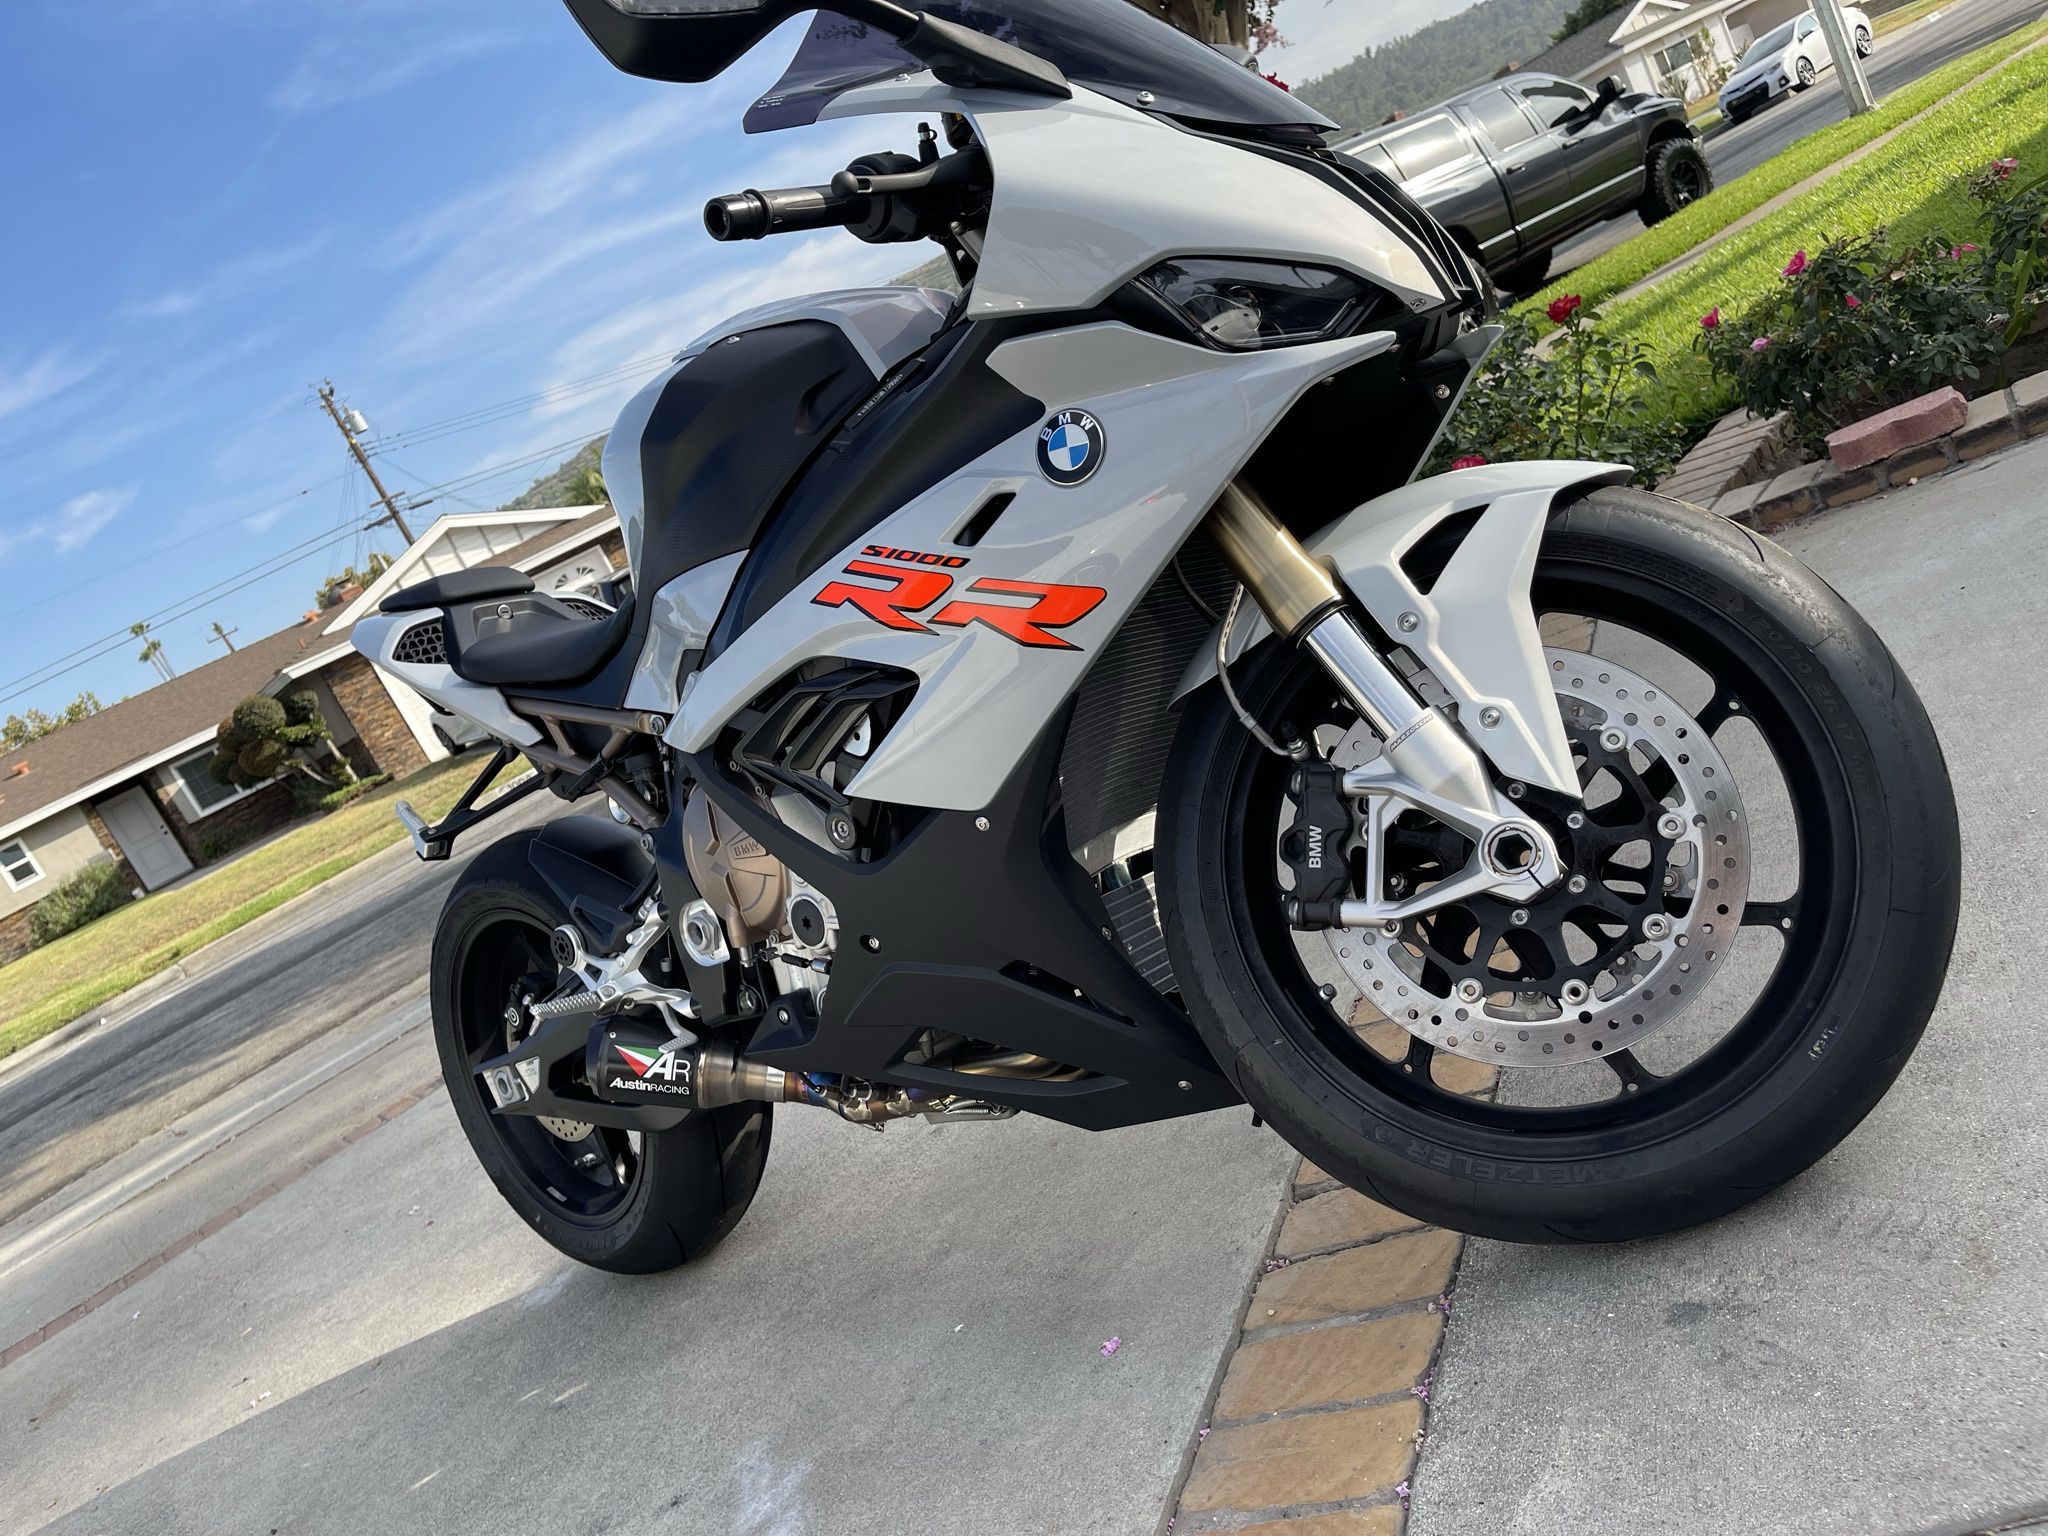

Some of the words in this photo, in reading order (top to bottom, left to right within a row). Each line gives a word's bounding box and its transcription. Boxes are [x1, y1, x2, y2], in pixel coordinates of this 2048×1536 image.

[1041, 412, 1095, 442] BMW
[861, 544, 971, 568] S1000
[810, 560, 1107, 651] RR
[1390, 713, 1434, 752] MARZOCCHI
[733, 841, 759, 857] BMW
[1308, 825, 1323, 869] BMW
[643, 1050, 690, 1083] AR
[1406, 1140, 1602, 1185] METZELER
